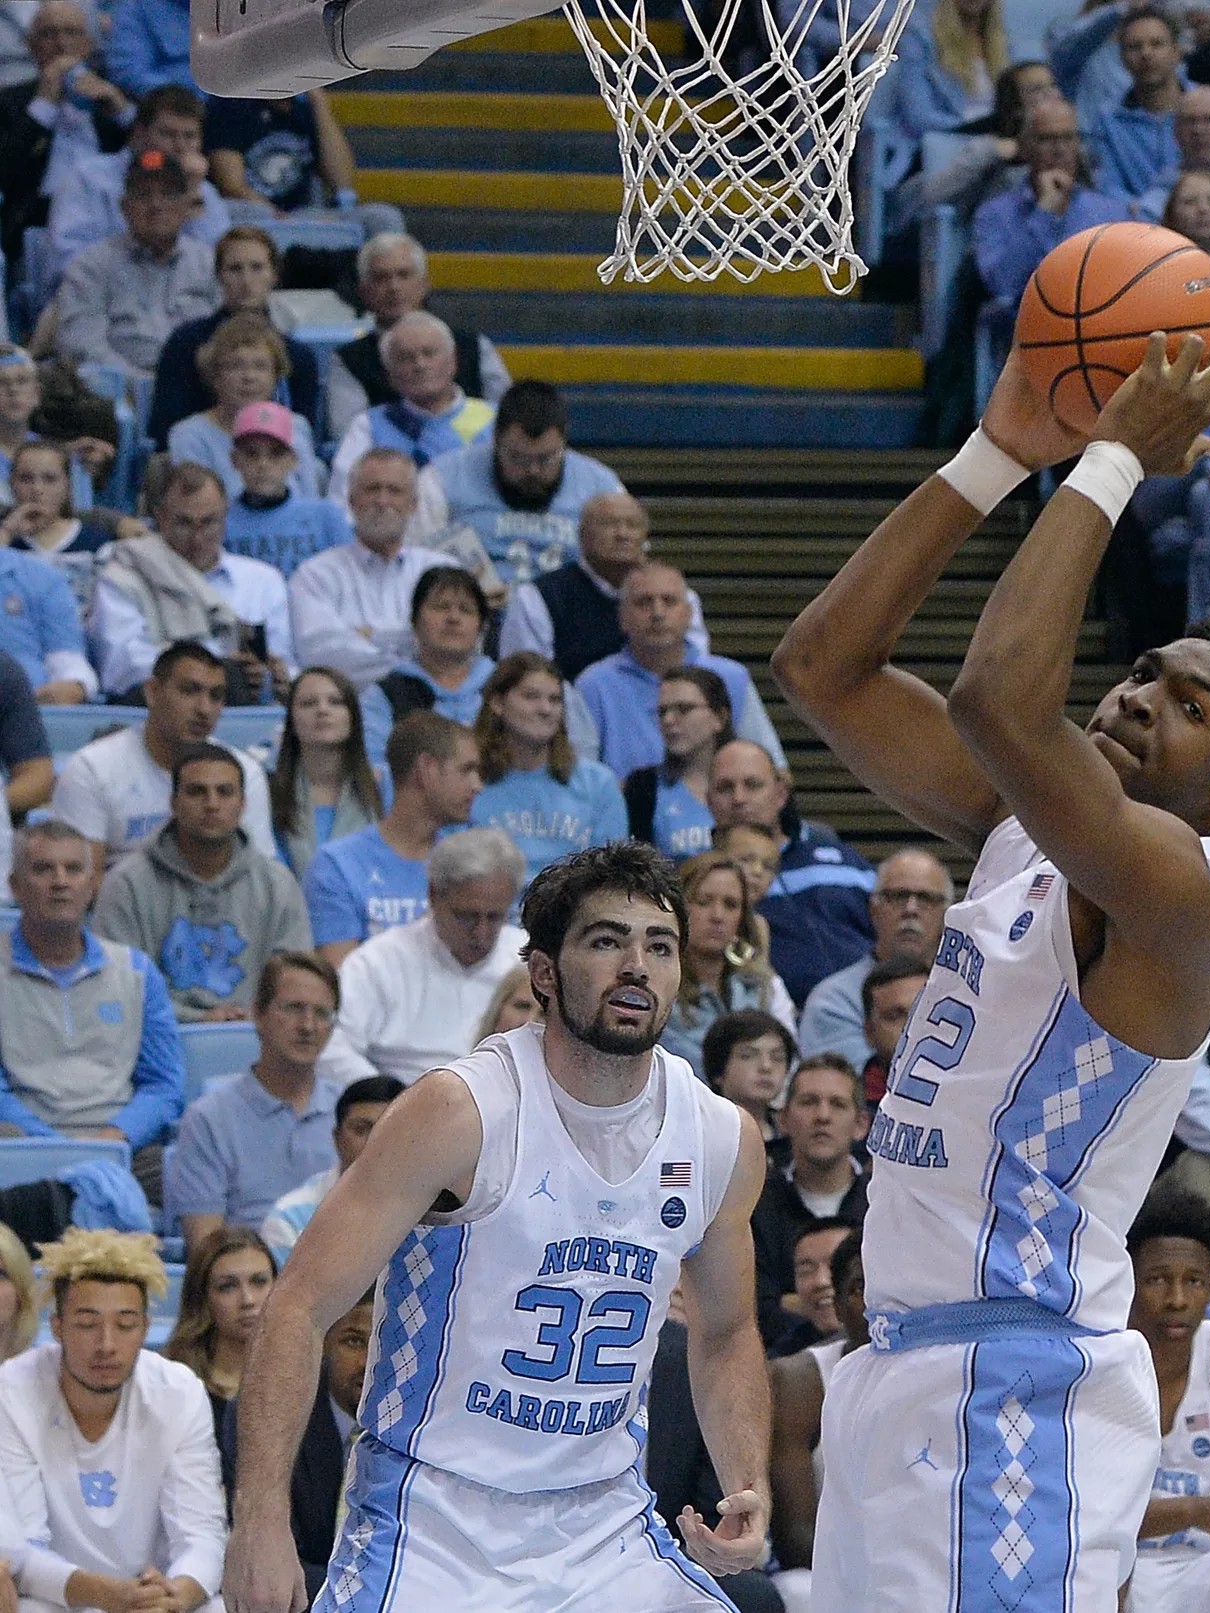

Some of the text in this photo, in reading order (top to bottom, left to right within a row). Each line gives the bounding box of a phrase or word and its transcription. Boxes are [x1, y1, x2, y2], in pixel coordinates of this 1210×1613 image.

[935, 926, 985, 997] RTH
[537, 1236, 658, 1285] NORTH
[501, 1283, 652, 1385] 32
